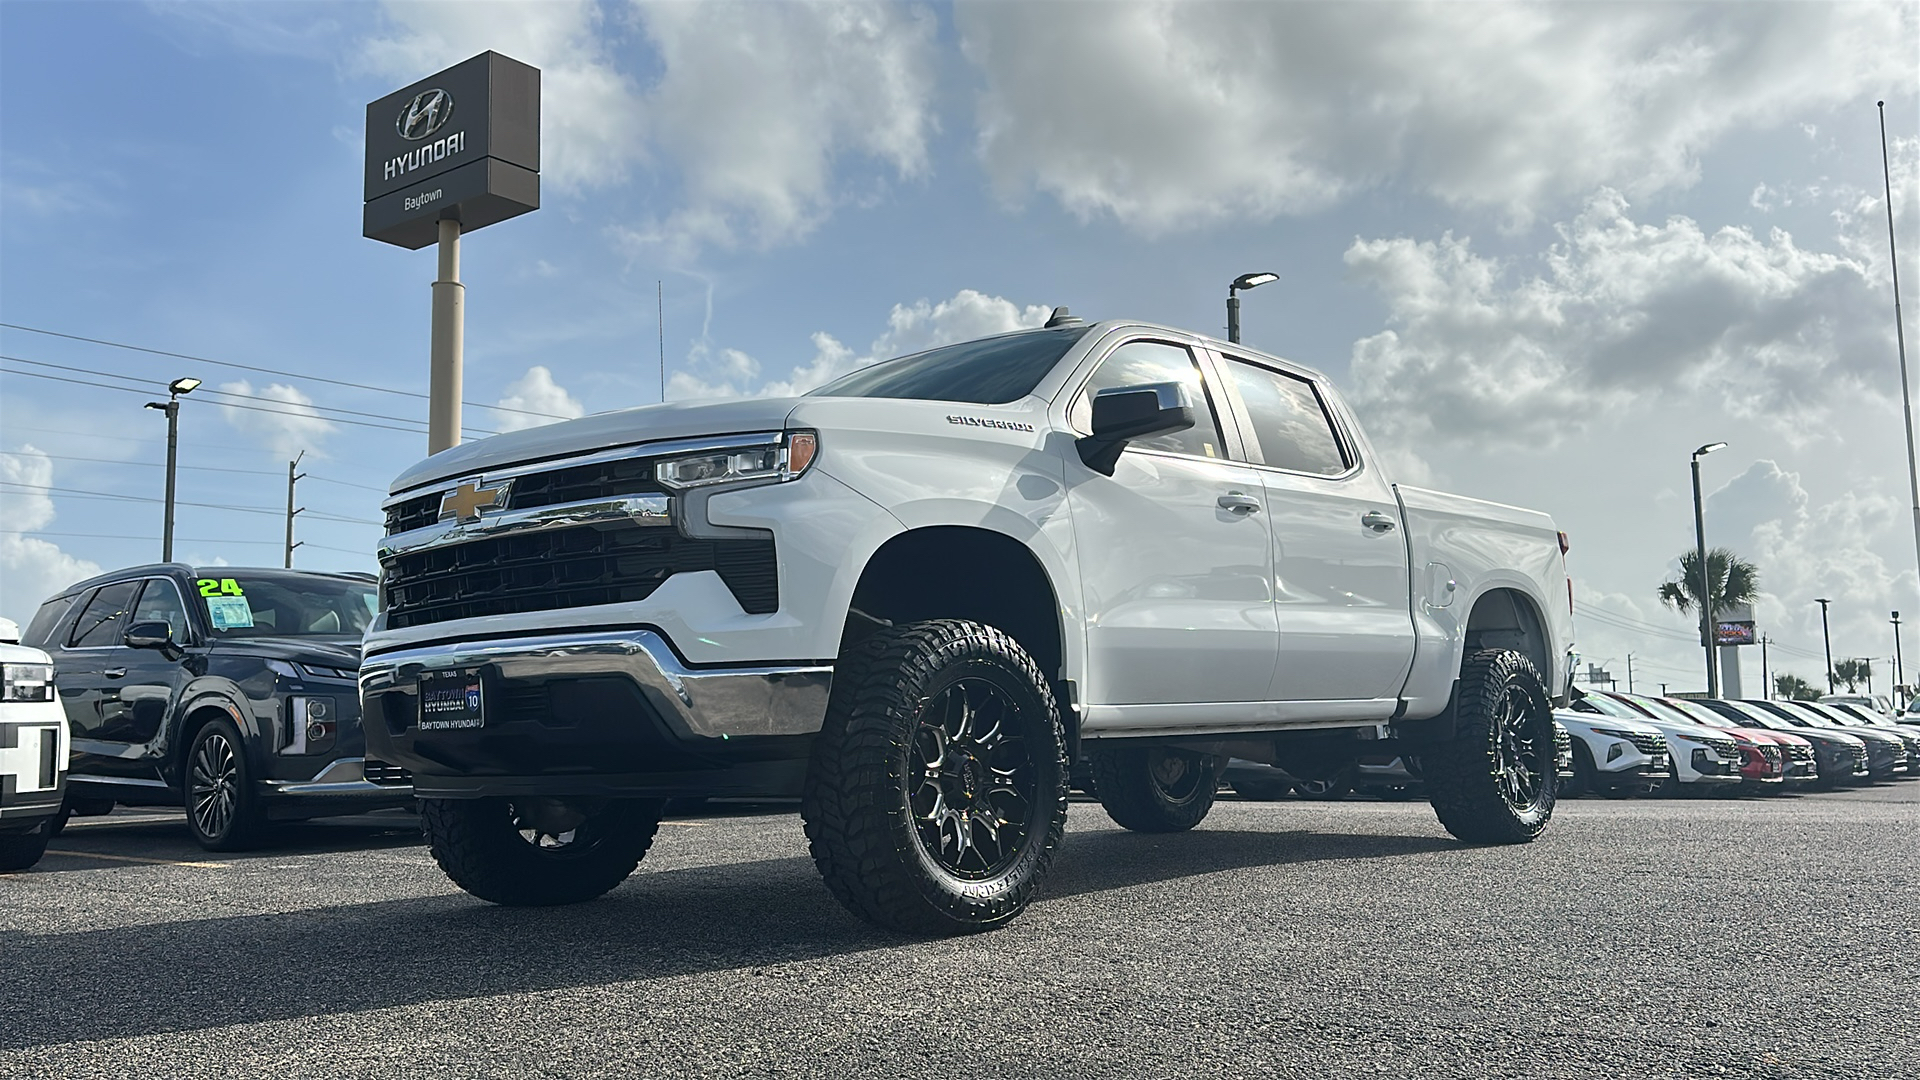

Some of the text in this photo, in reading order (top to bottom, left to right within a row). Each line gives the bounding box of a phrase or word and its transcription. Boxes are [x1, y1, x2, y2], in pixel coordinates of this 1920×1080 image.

[384, 131, 465, 181] HYUNDAI
[405, 188, 443, 211] Baytown
[946, 415, 1035, 432] SILVERADO
[196, 578, 244, 597] 24
[442, 670, 457, 678] TEXAS
[425, 700, 464, 713] HYUNDAI
[468, 695, 478, 708] 10
[421, 721, 450, 730] BAYTOWN
[450, 719, 476, 729] HYUNDAI
